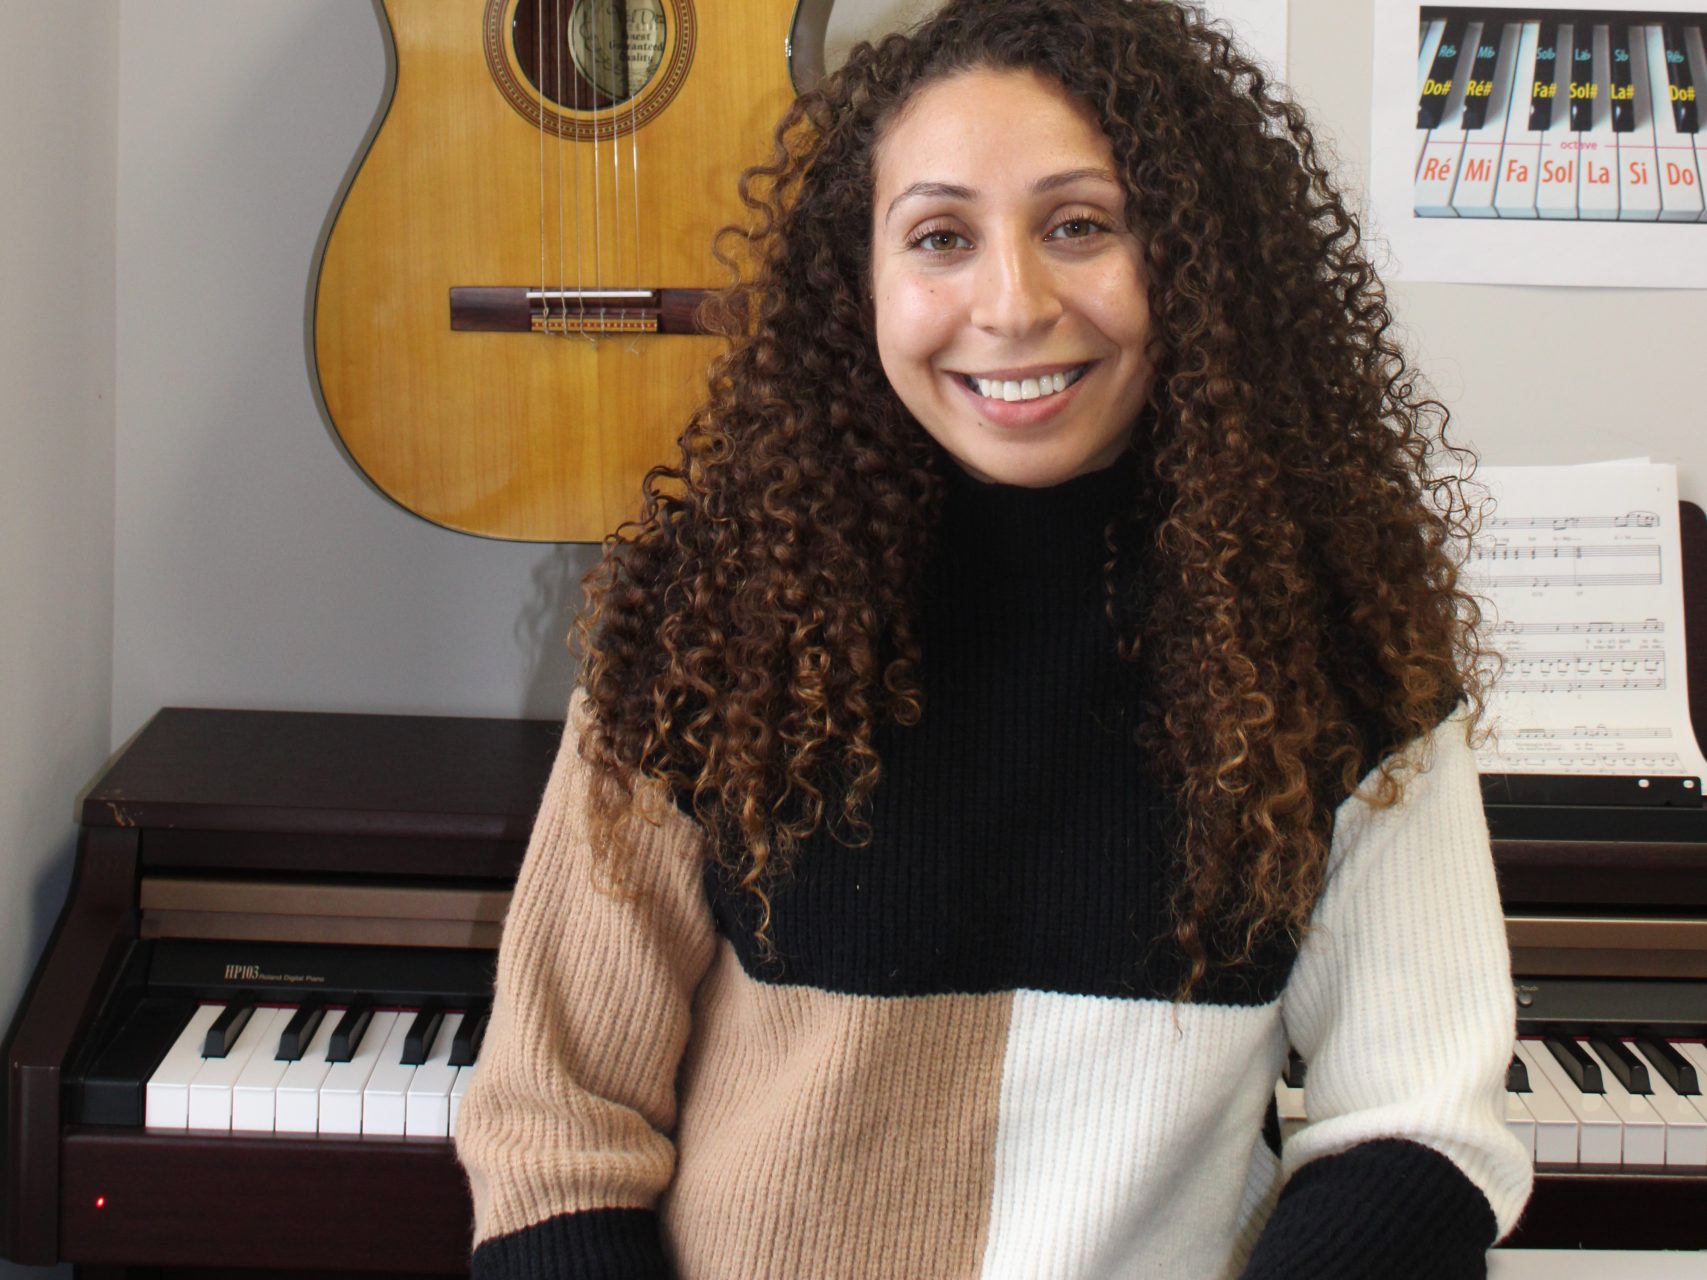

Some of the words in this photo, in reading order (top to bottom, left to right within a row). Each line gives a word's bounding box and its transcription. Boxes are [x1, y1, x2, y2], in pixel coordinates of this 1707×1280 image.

[609, 40, 663, 52] Granteed
[1423, 80, 1452, 96] Do#
[1466, 80, 1493, 96] Ré#
[1533, 81, 1557, 98] Fa#
[1568, 82, 1598, 99] Sol#
[1610, 83, 1635, 100] La#
[1669, 84, 1695, 101] Do#
[1560, 141, 1597, 150] octave
[1423, 158, 1451, 181] Ré
[1465, 158, 1491, 182] Mi
[1506, 159, 1528, 182] Fa
[1542, 160, 1573, 183] Sol
[1588, 160, 1610, 184] La
[1629, 161, 1647, 185] Si
[1666, 162, 1694, 186] Do
[283, 974, 304, 983] Digital
[305, 975, 325, 983] Piano
